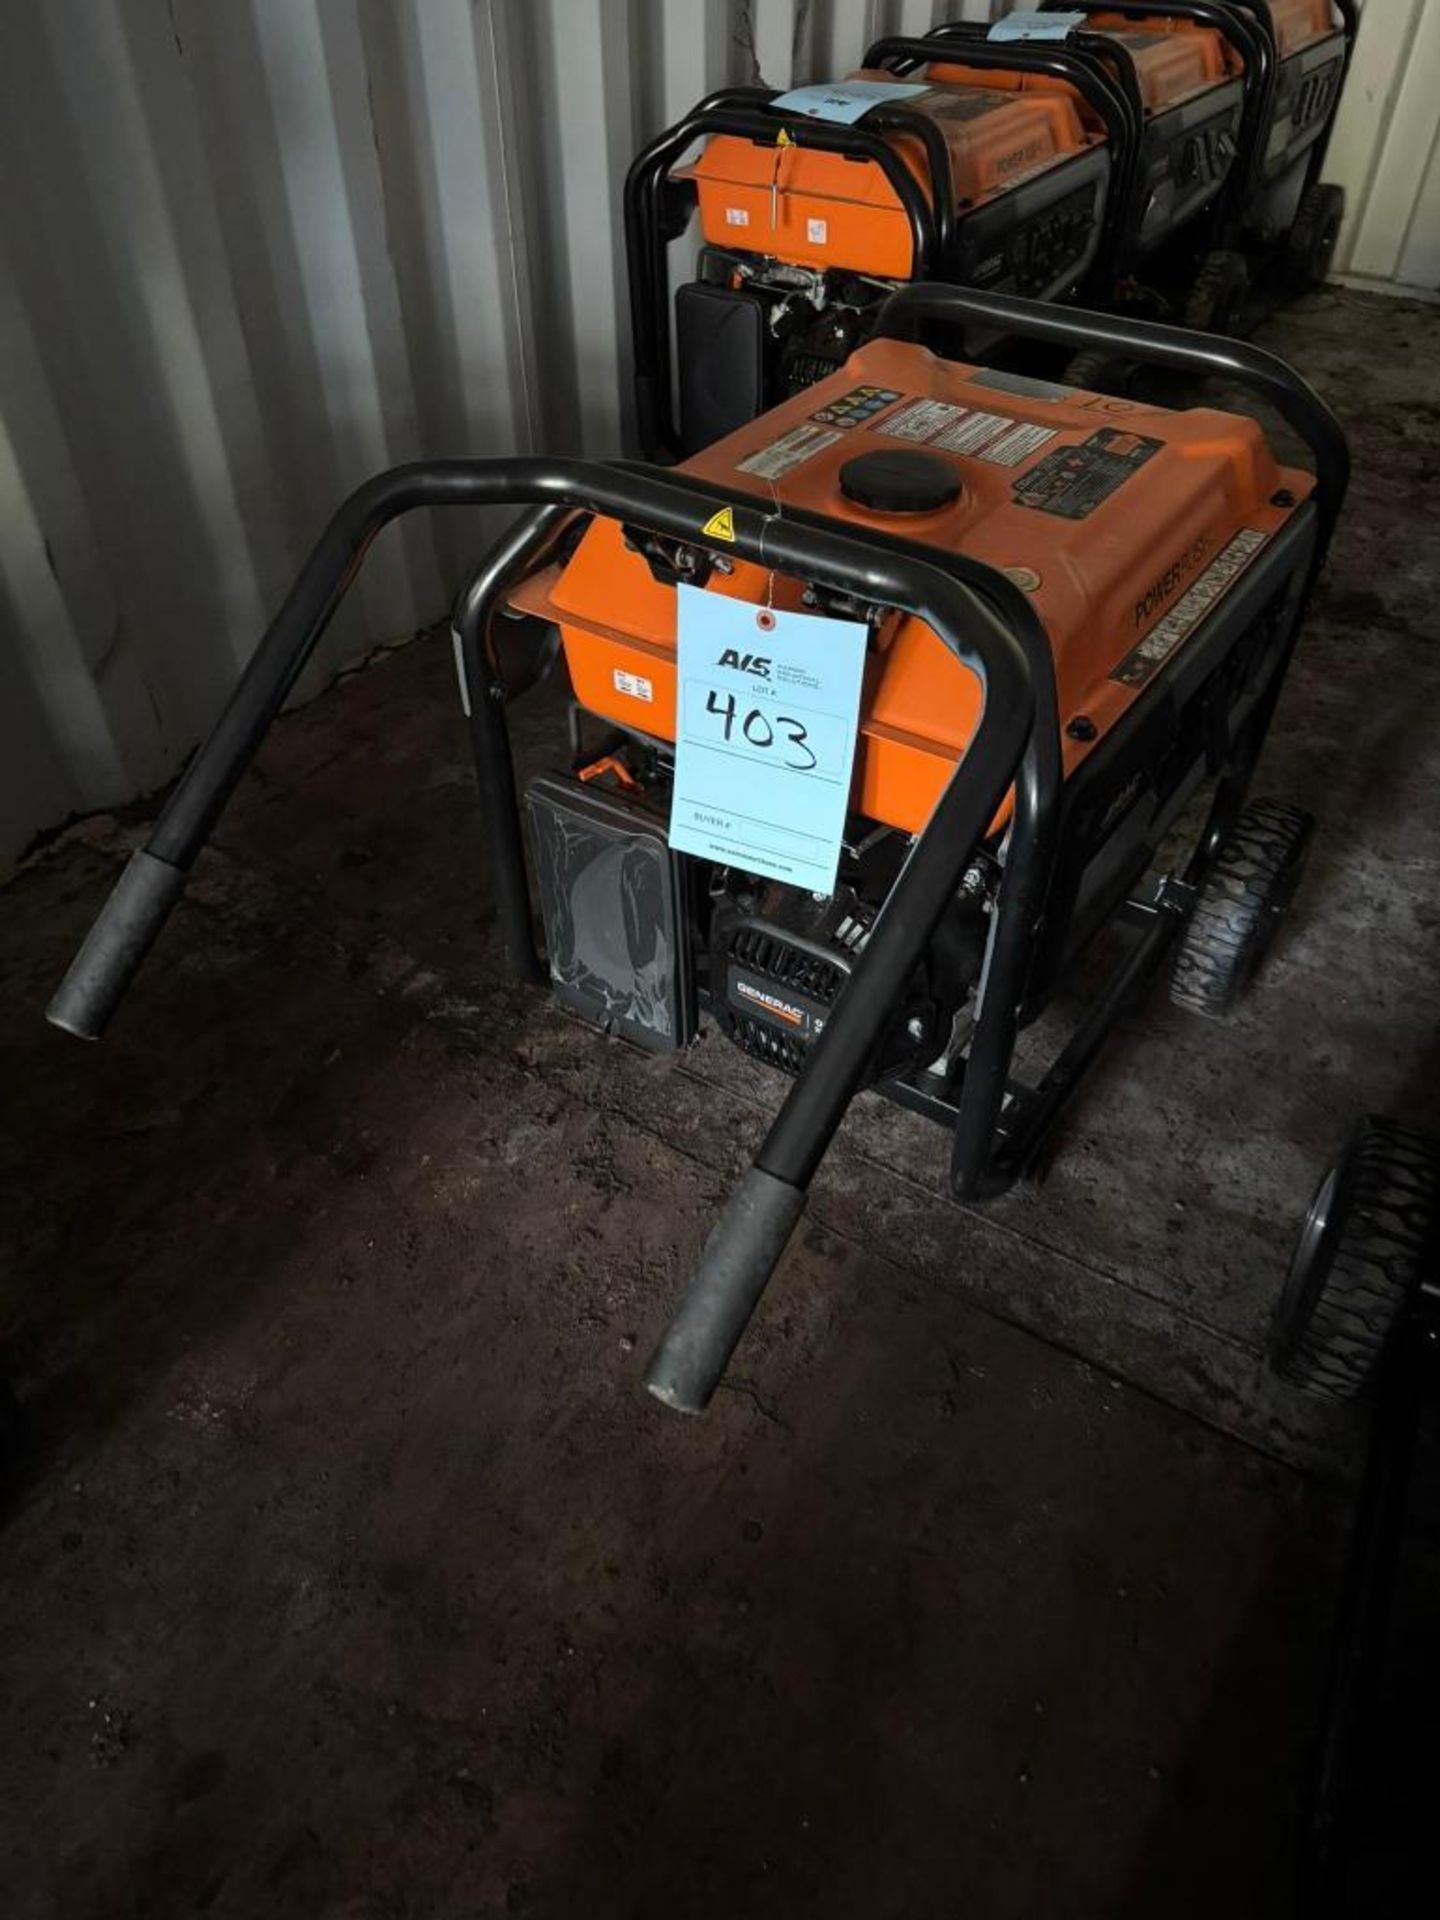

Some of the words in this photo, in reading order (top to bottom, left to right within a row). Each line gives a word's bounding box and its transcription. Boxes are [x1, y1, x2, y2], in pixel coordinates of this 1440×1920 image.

[752, 684, 769, 695] LOT
[706, 690, 817, 770] 403
[737, 981, 806, 1016] GENERAC
